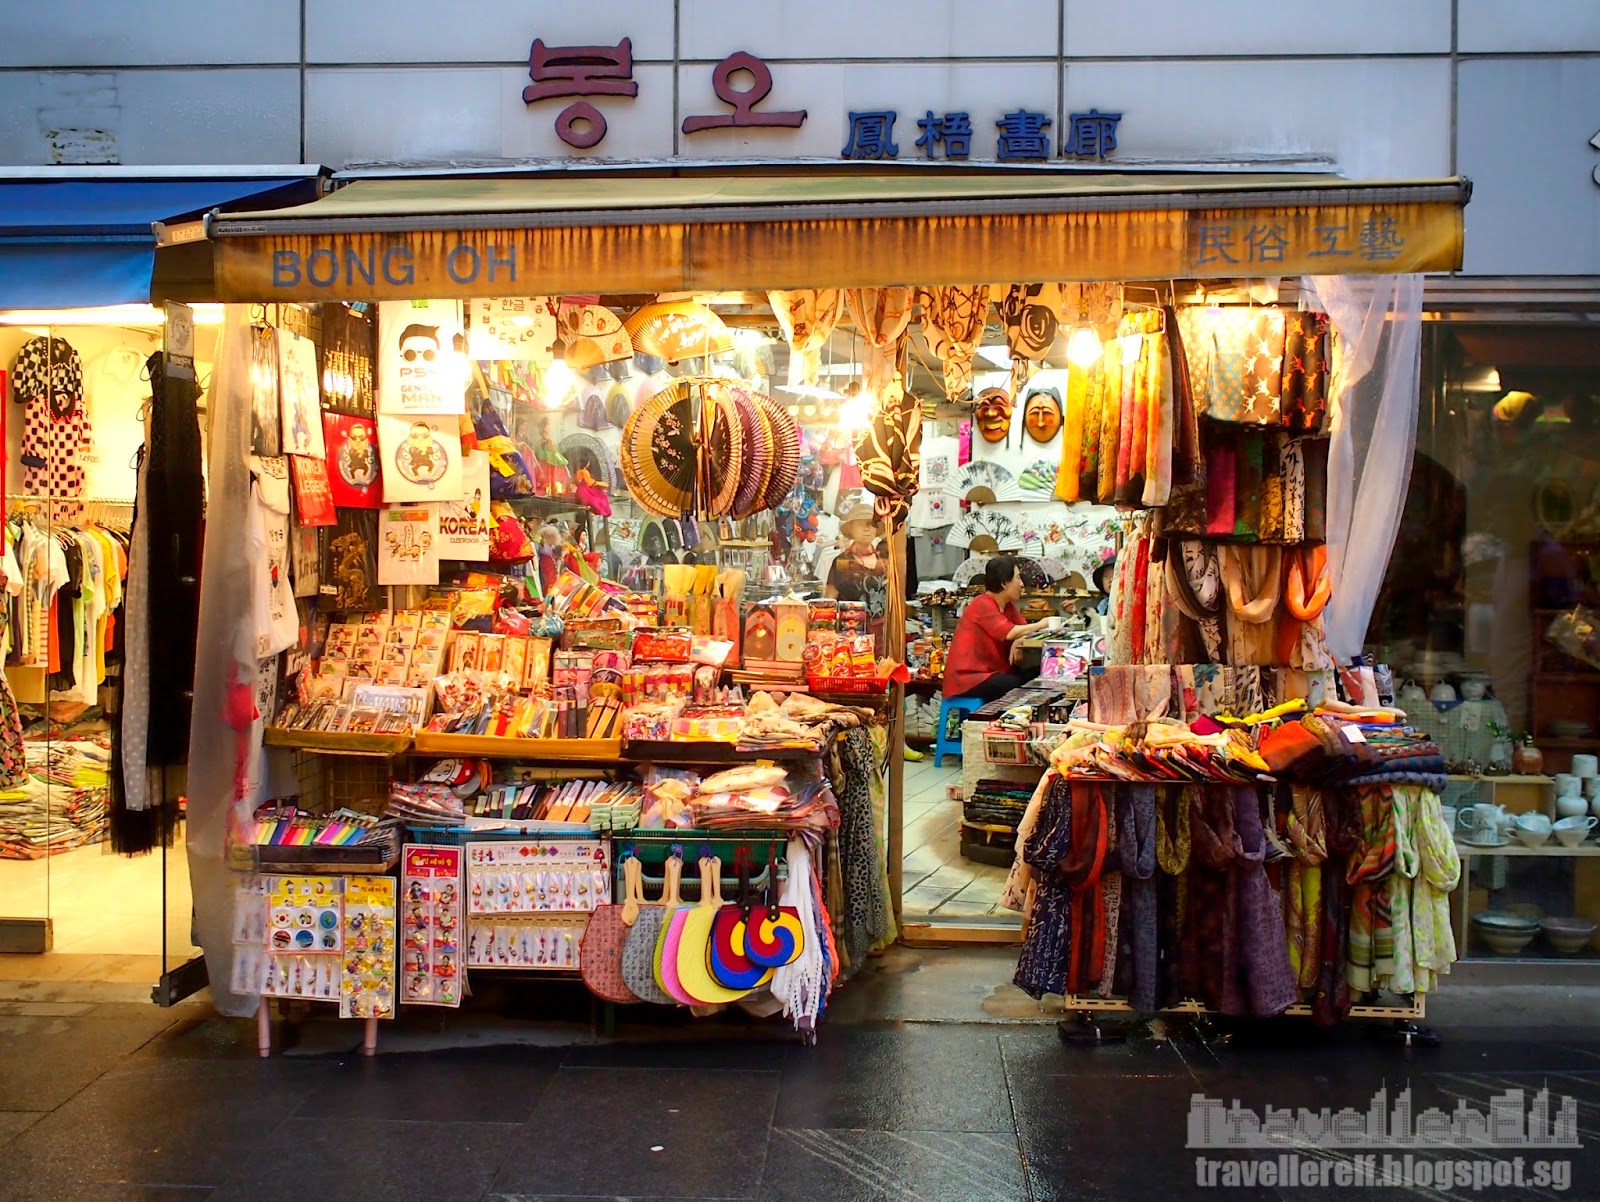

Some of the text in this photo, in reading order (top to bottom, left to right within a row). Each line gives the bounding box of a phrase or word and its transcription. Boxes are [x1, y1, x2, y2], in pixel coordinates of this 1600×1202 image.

[272, 243, 517, 288] BONG OH
[439, 516, 488, 535] KOREA
